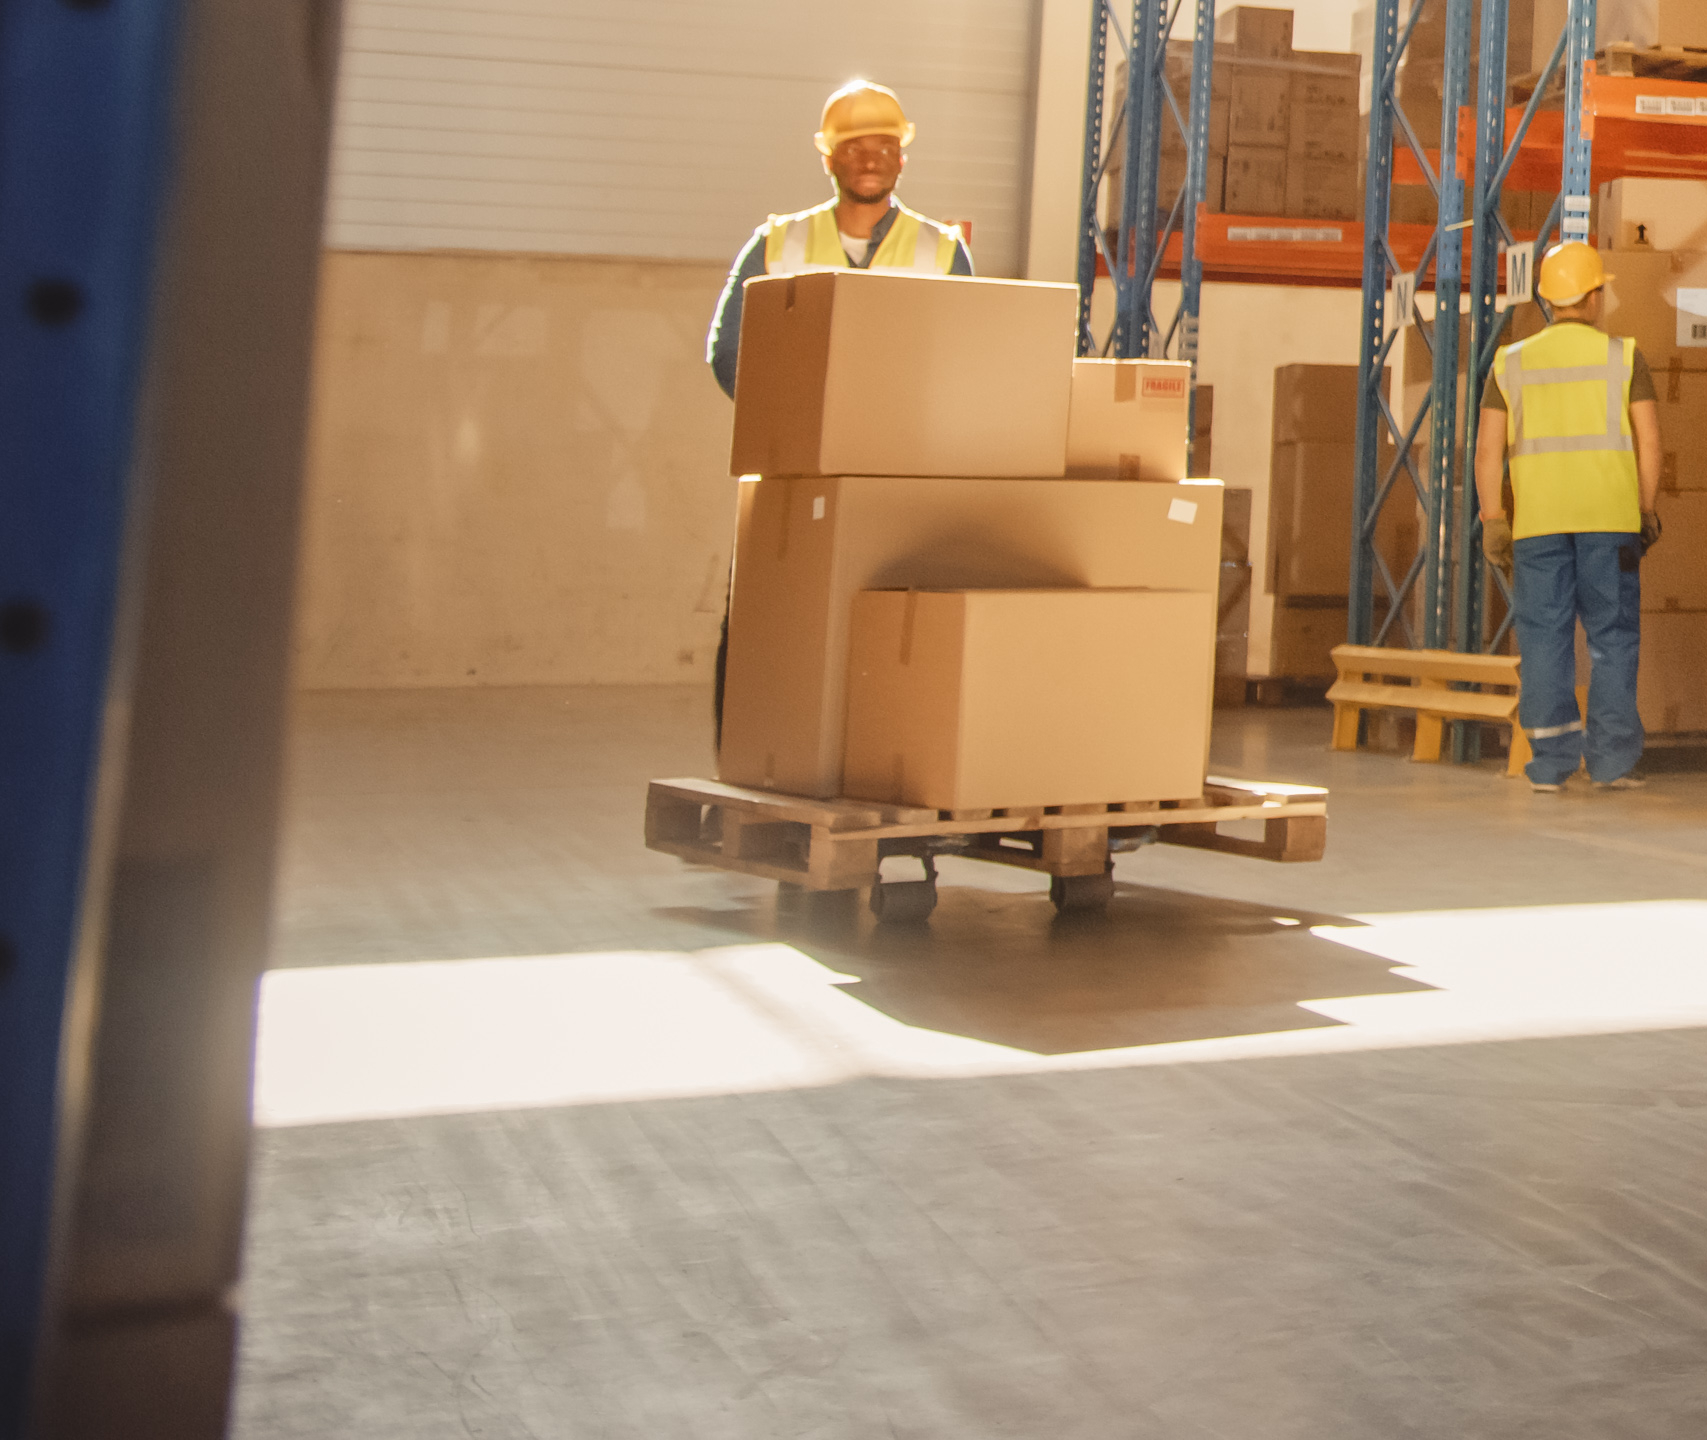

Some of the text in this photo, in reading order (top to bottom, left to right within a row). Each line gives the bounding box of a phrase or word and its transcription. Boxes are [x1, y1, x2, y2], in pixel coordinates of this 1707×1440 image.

[1512, 252, 1526, 296] M
[1396, 280, 1407, 322] N
[1146, 381, 1181, 392] FRAGILE
